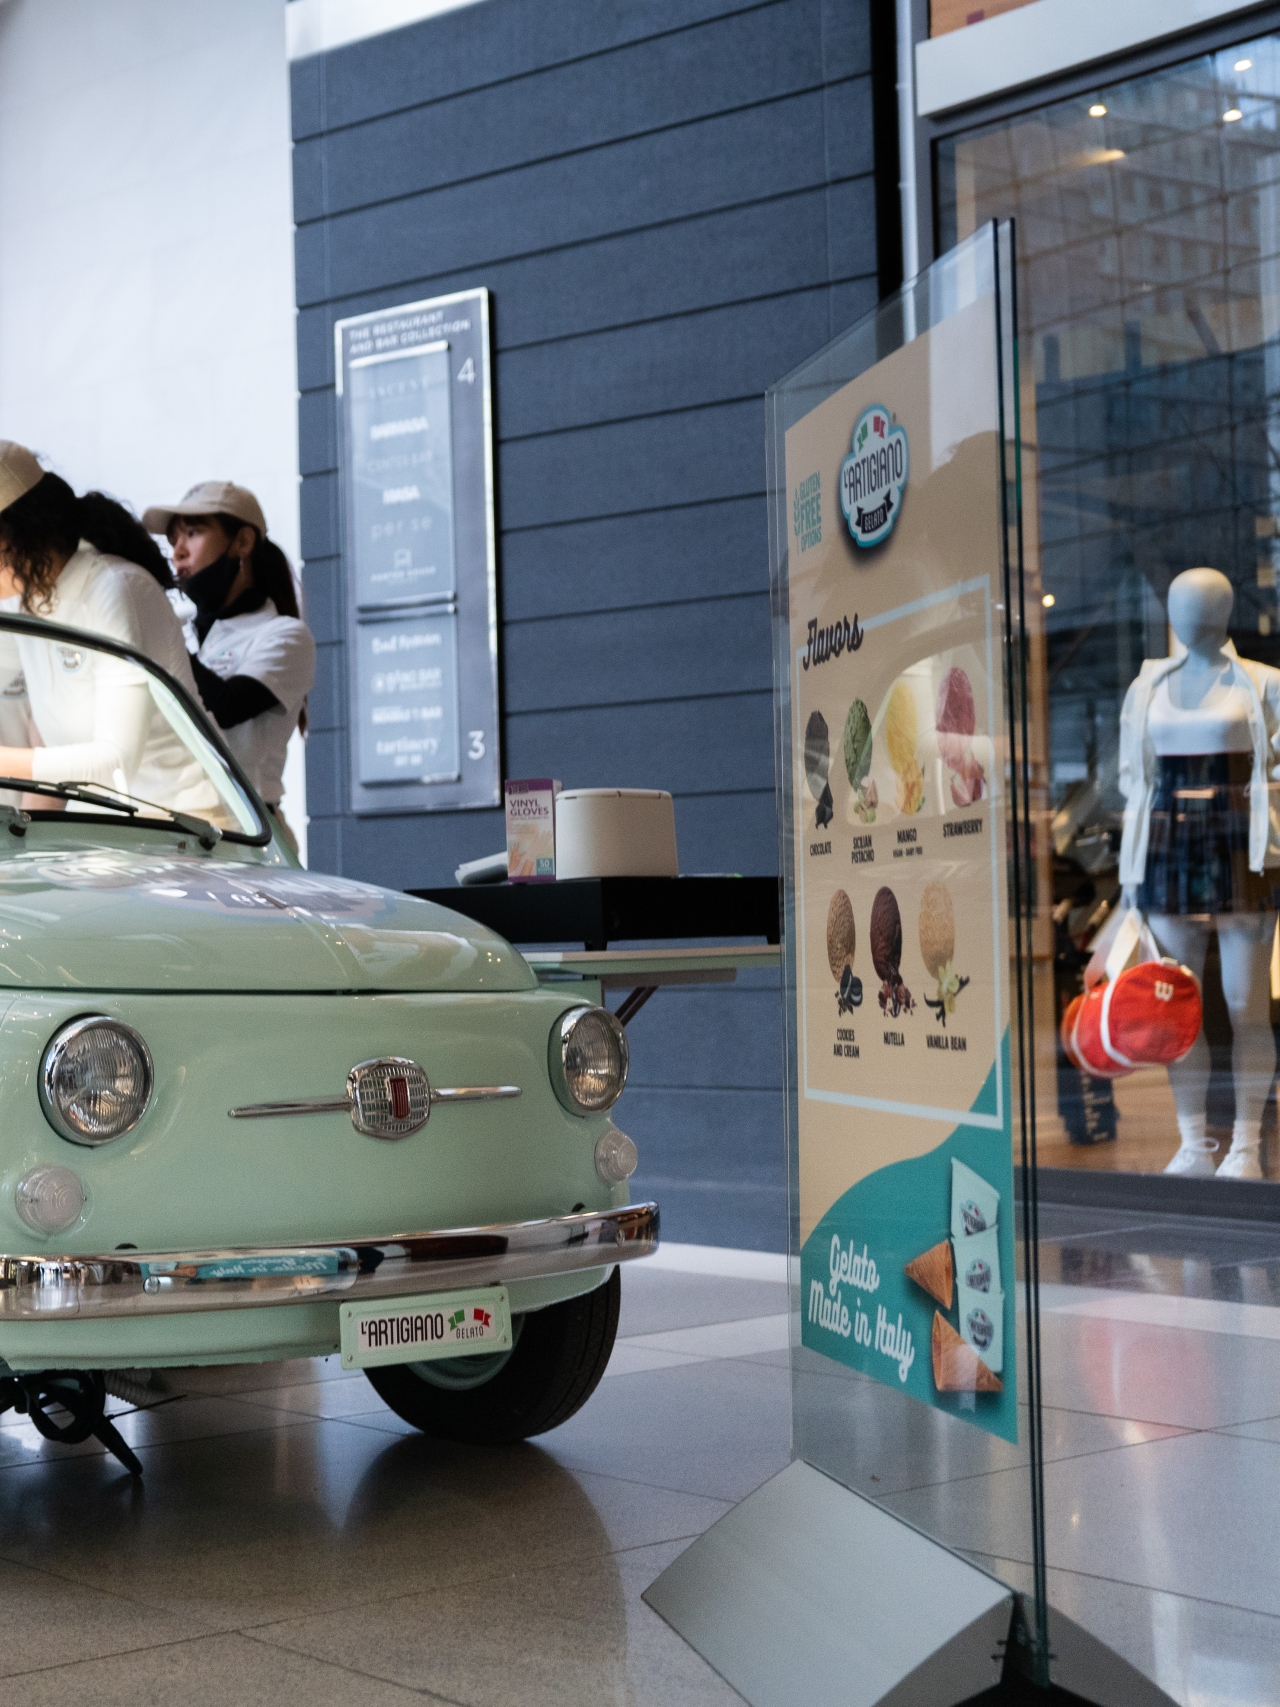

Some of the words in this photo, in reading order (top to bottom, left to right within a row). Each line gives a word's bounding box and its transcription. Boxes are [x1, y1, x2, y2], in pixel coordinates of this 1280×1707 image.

[349, 328, 370, 341] THE
[373, 310, 444, 336] RESTAURANT
[349, 340, 375, 354] AND
[376, 336, 398, 348] BAR
[400, 319, 470, 343] COLLECTION
[457, 357, 476, 385] 4
[844, 438, 903, 505] L'ARTIGIANO
[799, 471, 821, 500] GLUTEN
[800, 492, 822, 534] FREE
[864, 509, 885, 531] GELATO
[371, 519, 404, 542] per
[410, 515, 433, 535] se
[800, 526, 822, 553] OPTIONS
[802, 612, 864, 671] Flavors
[467, 730, 486, 760] 3
[509, 799, 538, 808] VINYL
[510, 807, 549, 817] GLOVES
[897, 828, 918, 844] MANGO
[942, 818, 983, 838] STRAWBERRY
[809, 841, 832, 857] CHOCOLATE
[853, 835, 873, 850] SICILIAN
[539, 859, 550, 867] 50
[851, 848, 875, 864] PISTACHIO
[836, 1028, 855, 1042] COOKIES
[883, 1031, 905, 1046] NUTELLA
[926, 1034, 949, 1050] VANILLA
[950, 1035, 967, 1051] BEAN
[833, 1043, 843, 1057] AND
[843, 1044, 860, 1058] CREAM
[829, 1233, 880, 1297] Gelato
[361, 1313, 444, 1348] L'ARTIGIANO
[456, 1326, 484, 1339] GELATO
[808, 1279, 852, 1338] Made
[854, 1297, 872, 1347] in
[874, 1303, 915, 1383] Italy
